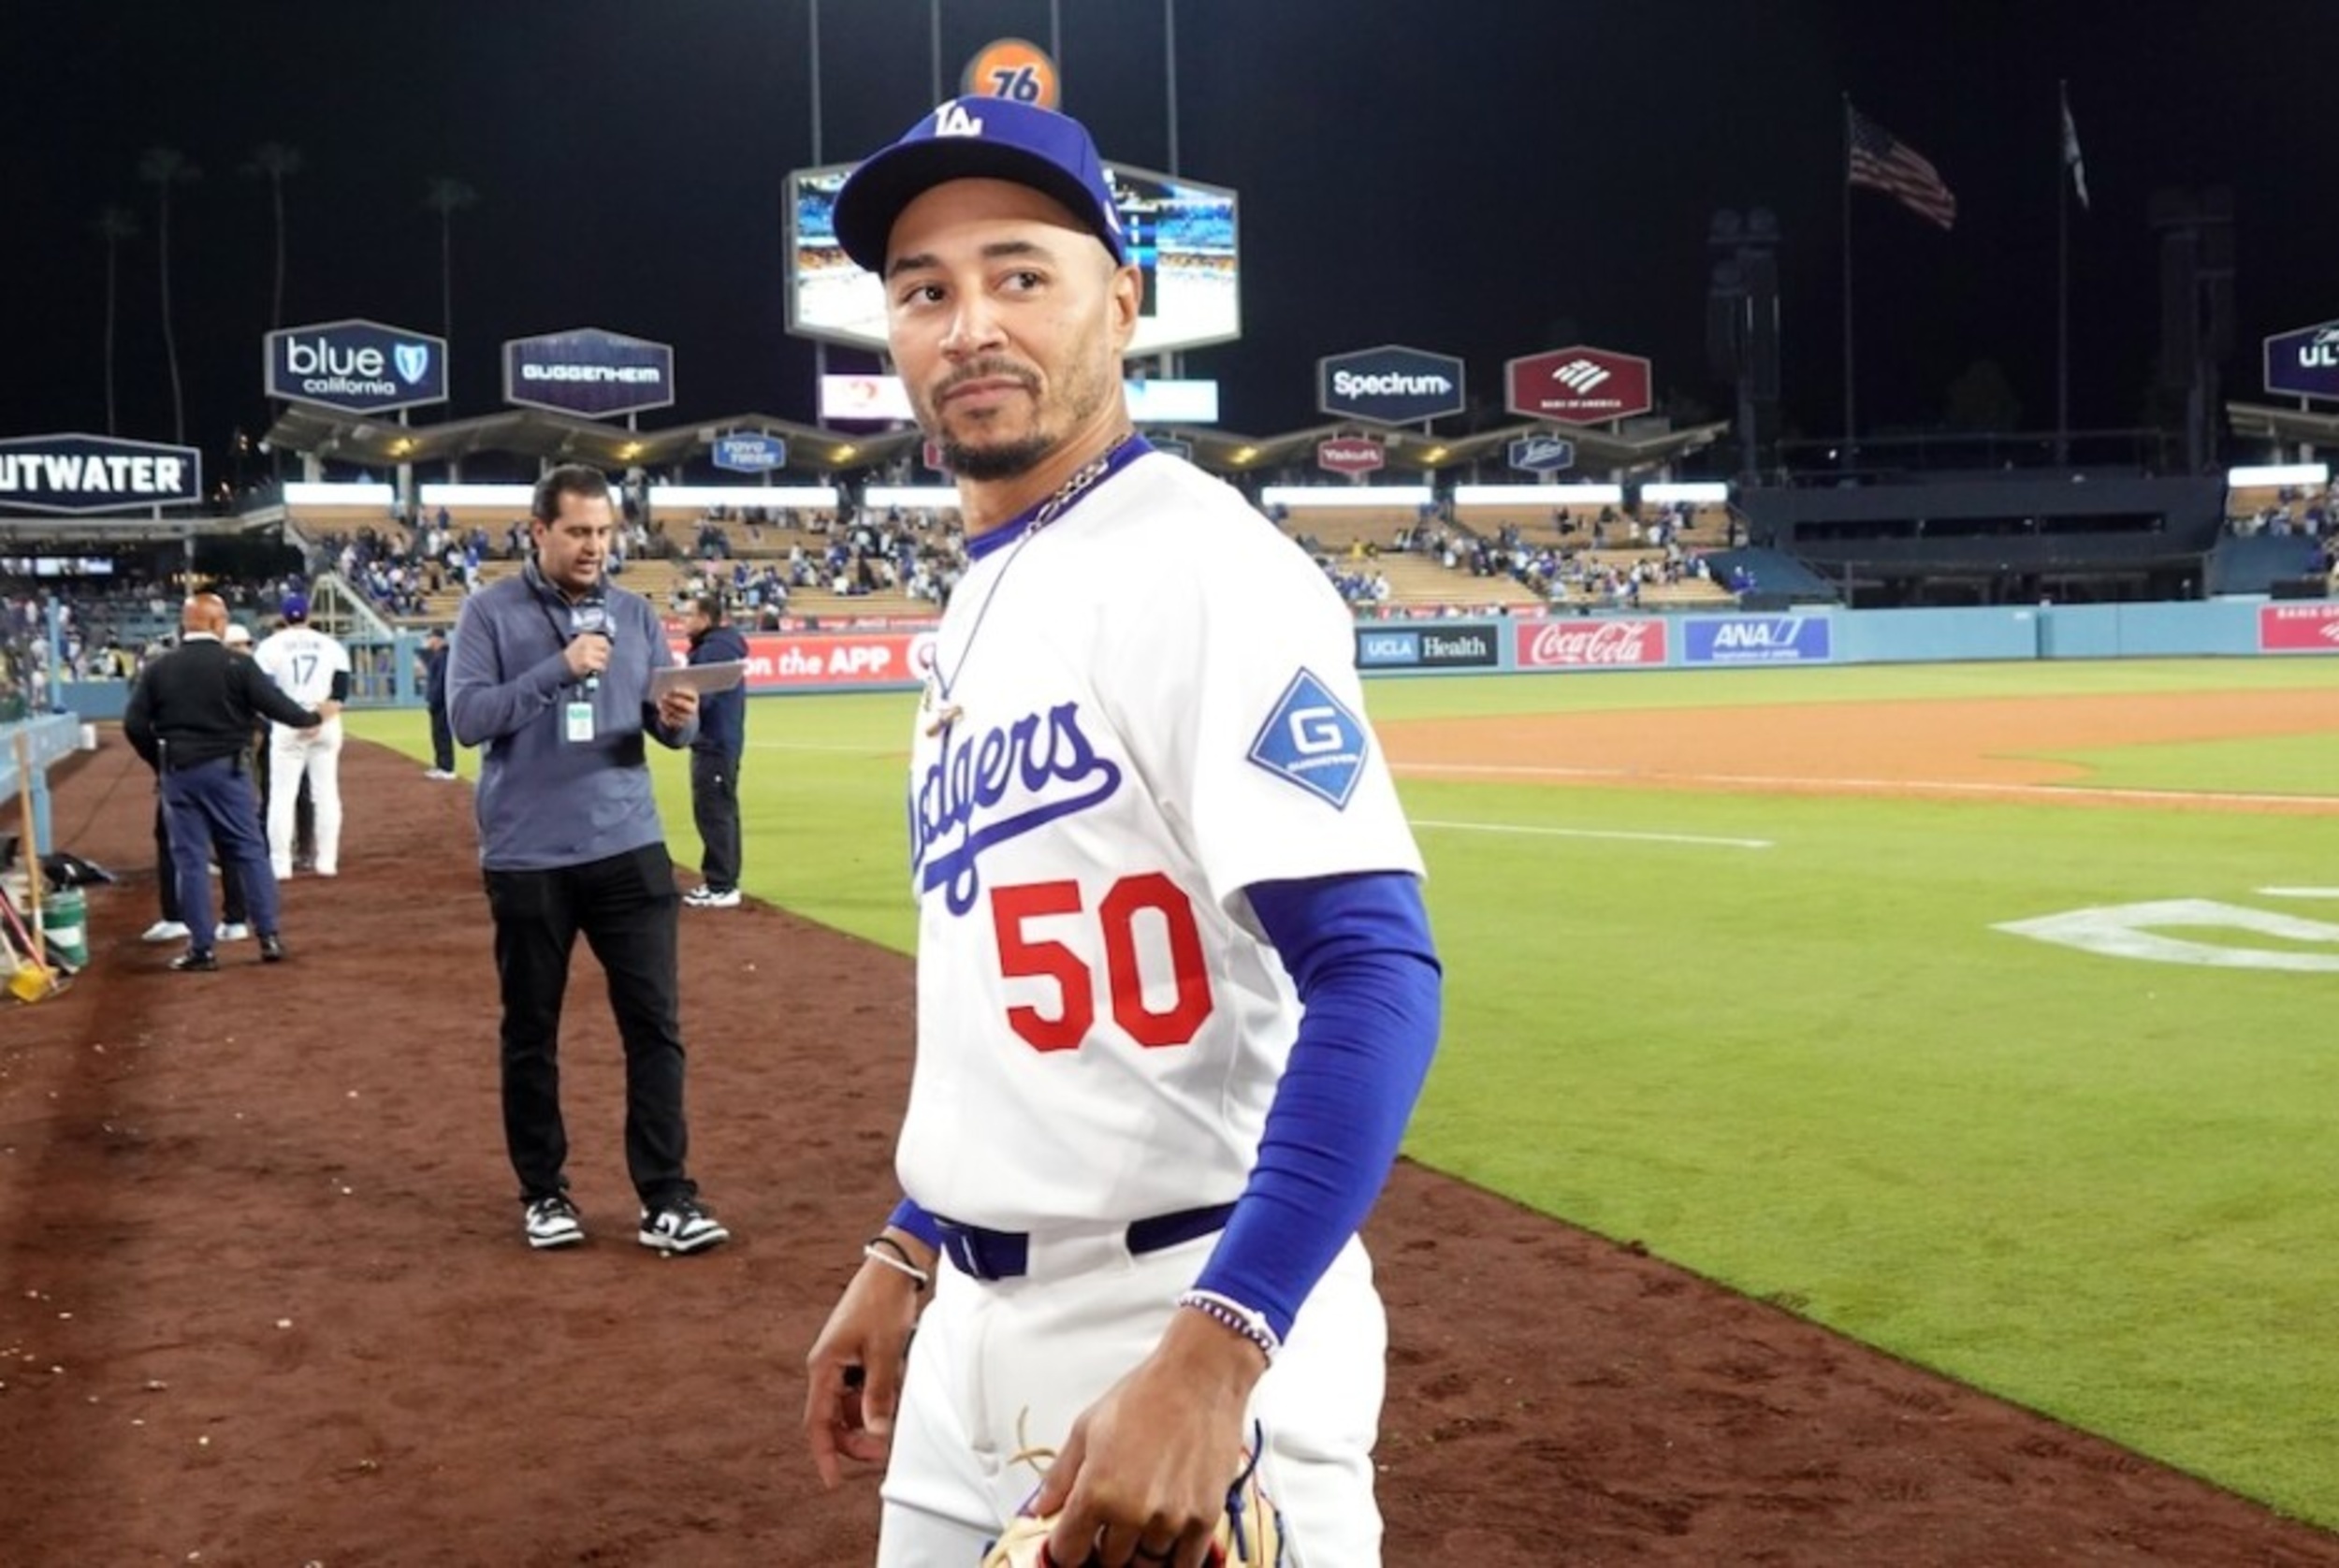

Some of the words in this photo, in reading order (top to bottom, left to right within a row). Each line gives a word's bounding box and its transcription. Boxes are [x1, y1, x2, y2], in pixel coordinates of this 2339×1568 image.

[992, 65, 1039, 102] 76
[935, 99, 982, 138] LA
[287, 336, 384, 377] blue
[2299, 344, 2339, 368] UL
[302, 376, 397, 396] california
[521, 363, 660, 384] GUGGENHEIM
[1333, 370, 1447, 400] Spectrum
[1367, 639, 1412, 656] UCLA
[1423, 635, 1487, 657] Health
[1531, 623, 1649, 664] Coca-Cola
[1713, 622, 1771, 648] ANA
[291, 655, 318, 685] 17
[778, 646, 822, 675] the
[828, 645, 892, 675] APP
[1289, 706, 1344, 754] G
[908, 701, 1122, 917] odgers
[990, 871, 1213, 1053] 50
